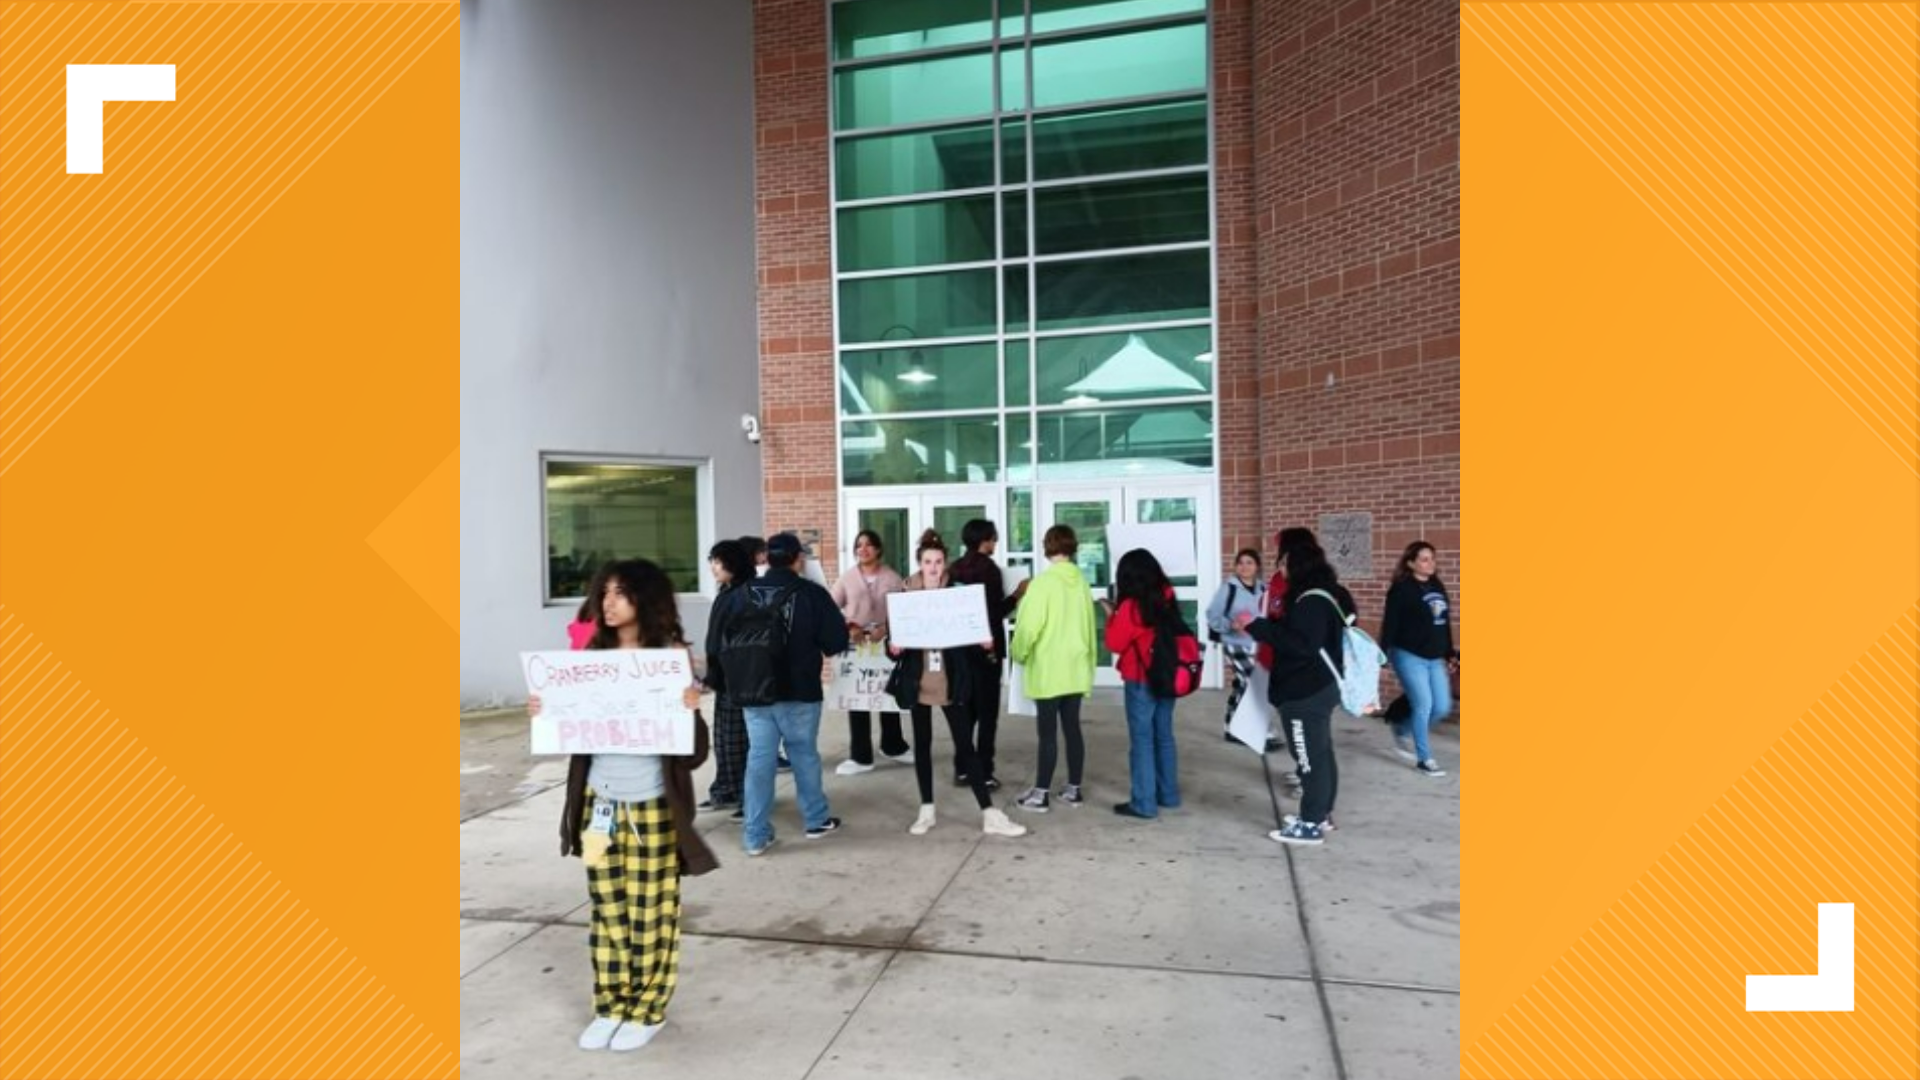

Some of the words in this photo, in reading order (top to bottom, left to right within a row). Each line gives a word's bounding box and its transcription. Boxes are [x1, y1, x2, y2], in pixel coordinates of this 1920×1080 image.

[528, 654, 620, 690] CRANBERRY
[628, 652, 681, 679] JUICE
[859, 668, 880, 680] YOU
[856, 678, 889, 694] LEA
[558, 718, 676, 750] PROBLEM
